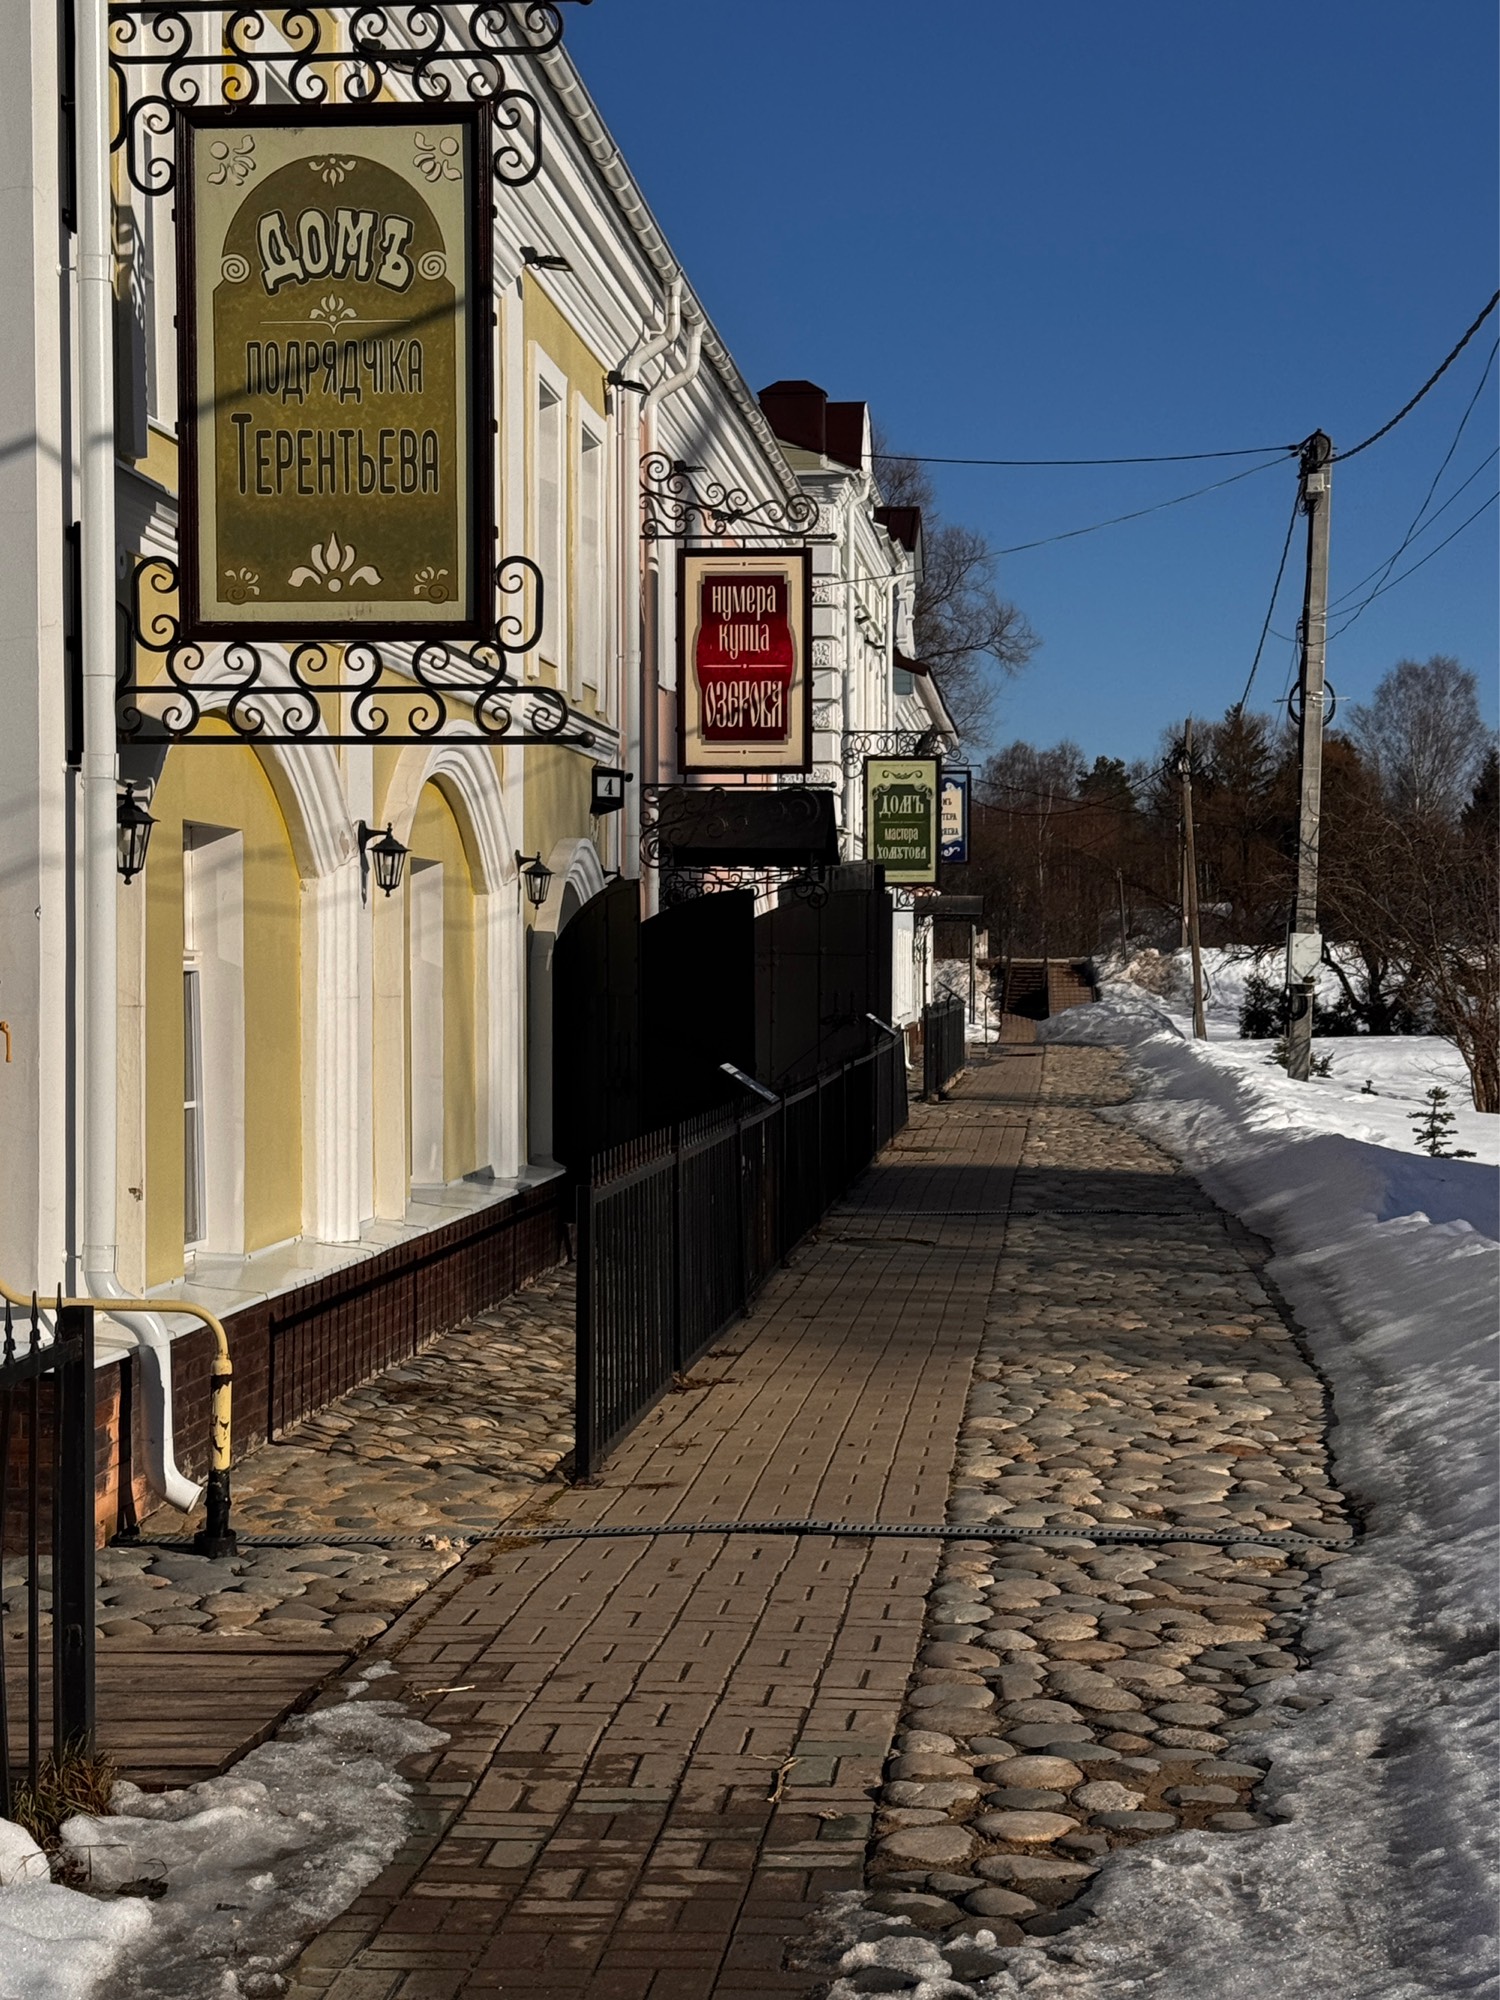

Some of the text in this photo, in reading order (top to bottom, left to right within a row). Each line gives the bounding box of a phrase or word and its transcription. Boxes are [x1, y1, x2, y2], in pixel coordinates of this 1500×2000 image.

[257, 207, 414, 295] ДОМЪ
[604, 778, 614, 796] 4
[878, 795, 924, 818] ДОМЪ
[941, 813, 958, 821] ТЕРА
